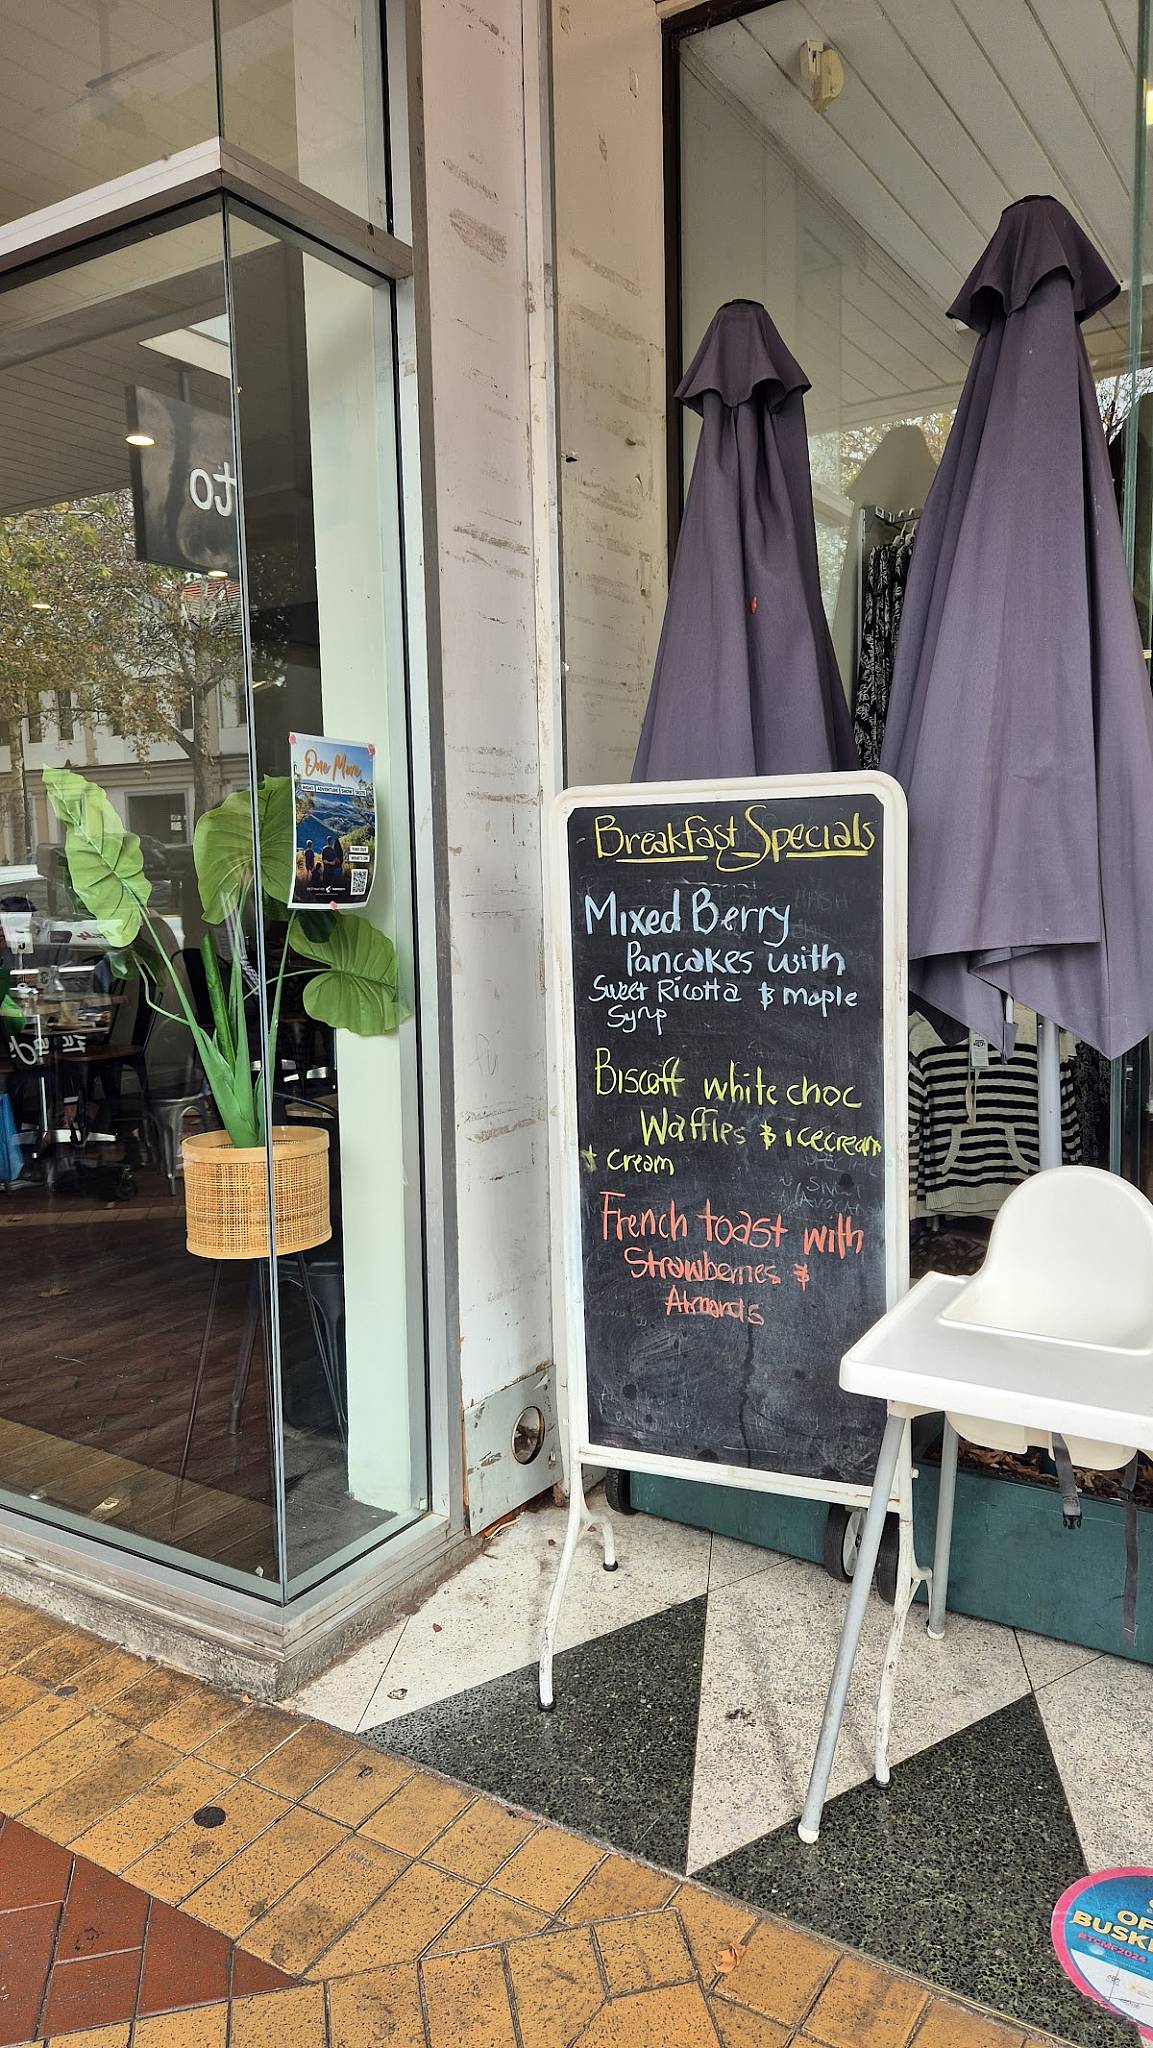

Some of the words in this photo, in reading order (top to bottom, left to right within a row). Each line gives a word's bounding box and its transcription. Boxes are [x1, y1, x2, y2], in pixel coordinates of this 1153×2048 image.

[304, 749, 331, 776] One
[332, 752, 362, 781] More
[594, 814, 737, 859] Breakfast
[717, 805, 876, 872] Specials
[584, 888, 681, 937] Mixed
[692, 887, 791, 948] Berry
[626, 941, 754, 977] Pancakes
[768, 943, 846, 977] with
[588, 975, 648, 1002] Sweet
[657, 977, 742, 1003] Ricotta
[594, 1048, 685, 1097] Biscoff
[704, 1060, 778, 1105] white
[787, 1076, 862, 1109] choc
[640, 1107, 746, 1147] Waffles
[600, 1191, 688, 1242] French
[699, 1199, 788, 1249] toast
[803, 1213, 864, 1259] with
